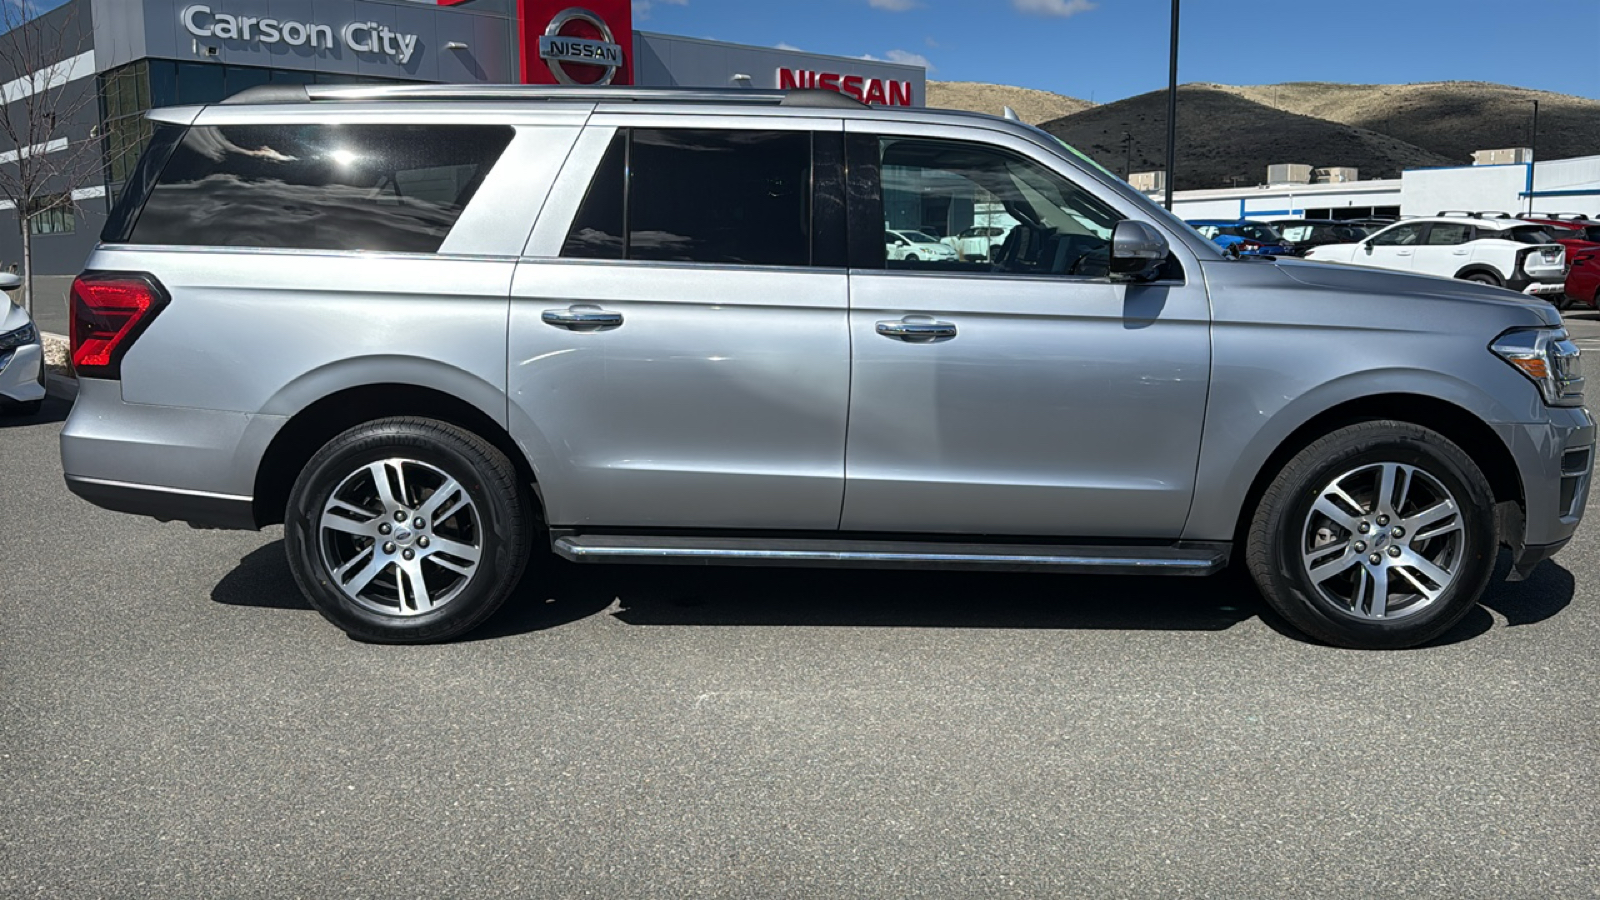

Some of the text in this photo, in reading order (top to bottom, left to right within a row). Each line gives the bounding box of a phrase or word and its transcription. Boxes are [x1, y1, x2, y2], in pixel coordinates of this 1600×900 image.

[183, 5, 417, 64] Carson City
[550, 40, 617, 61] NISSAN
[778, 67, 911, 106] NISSAN
